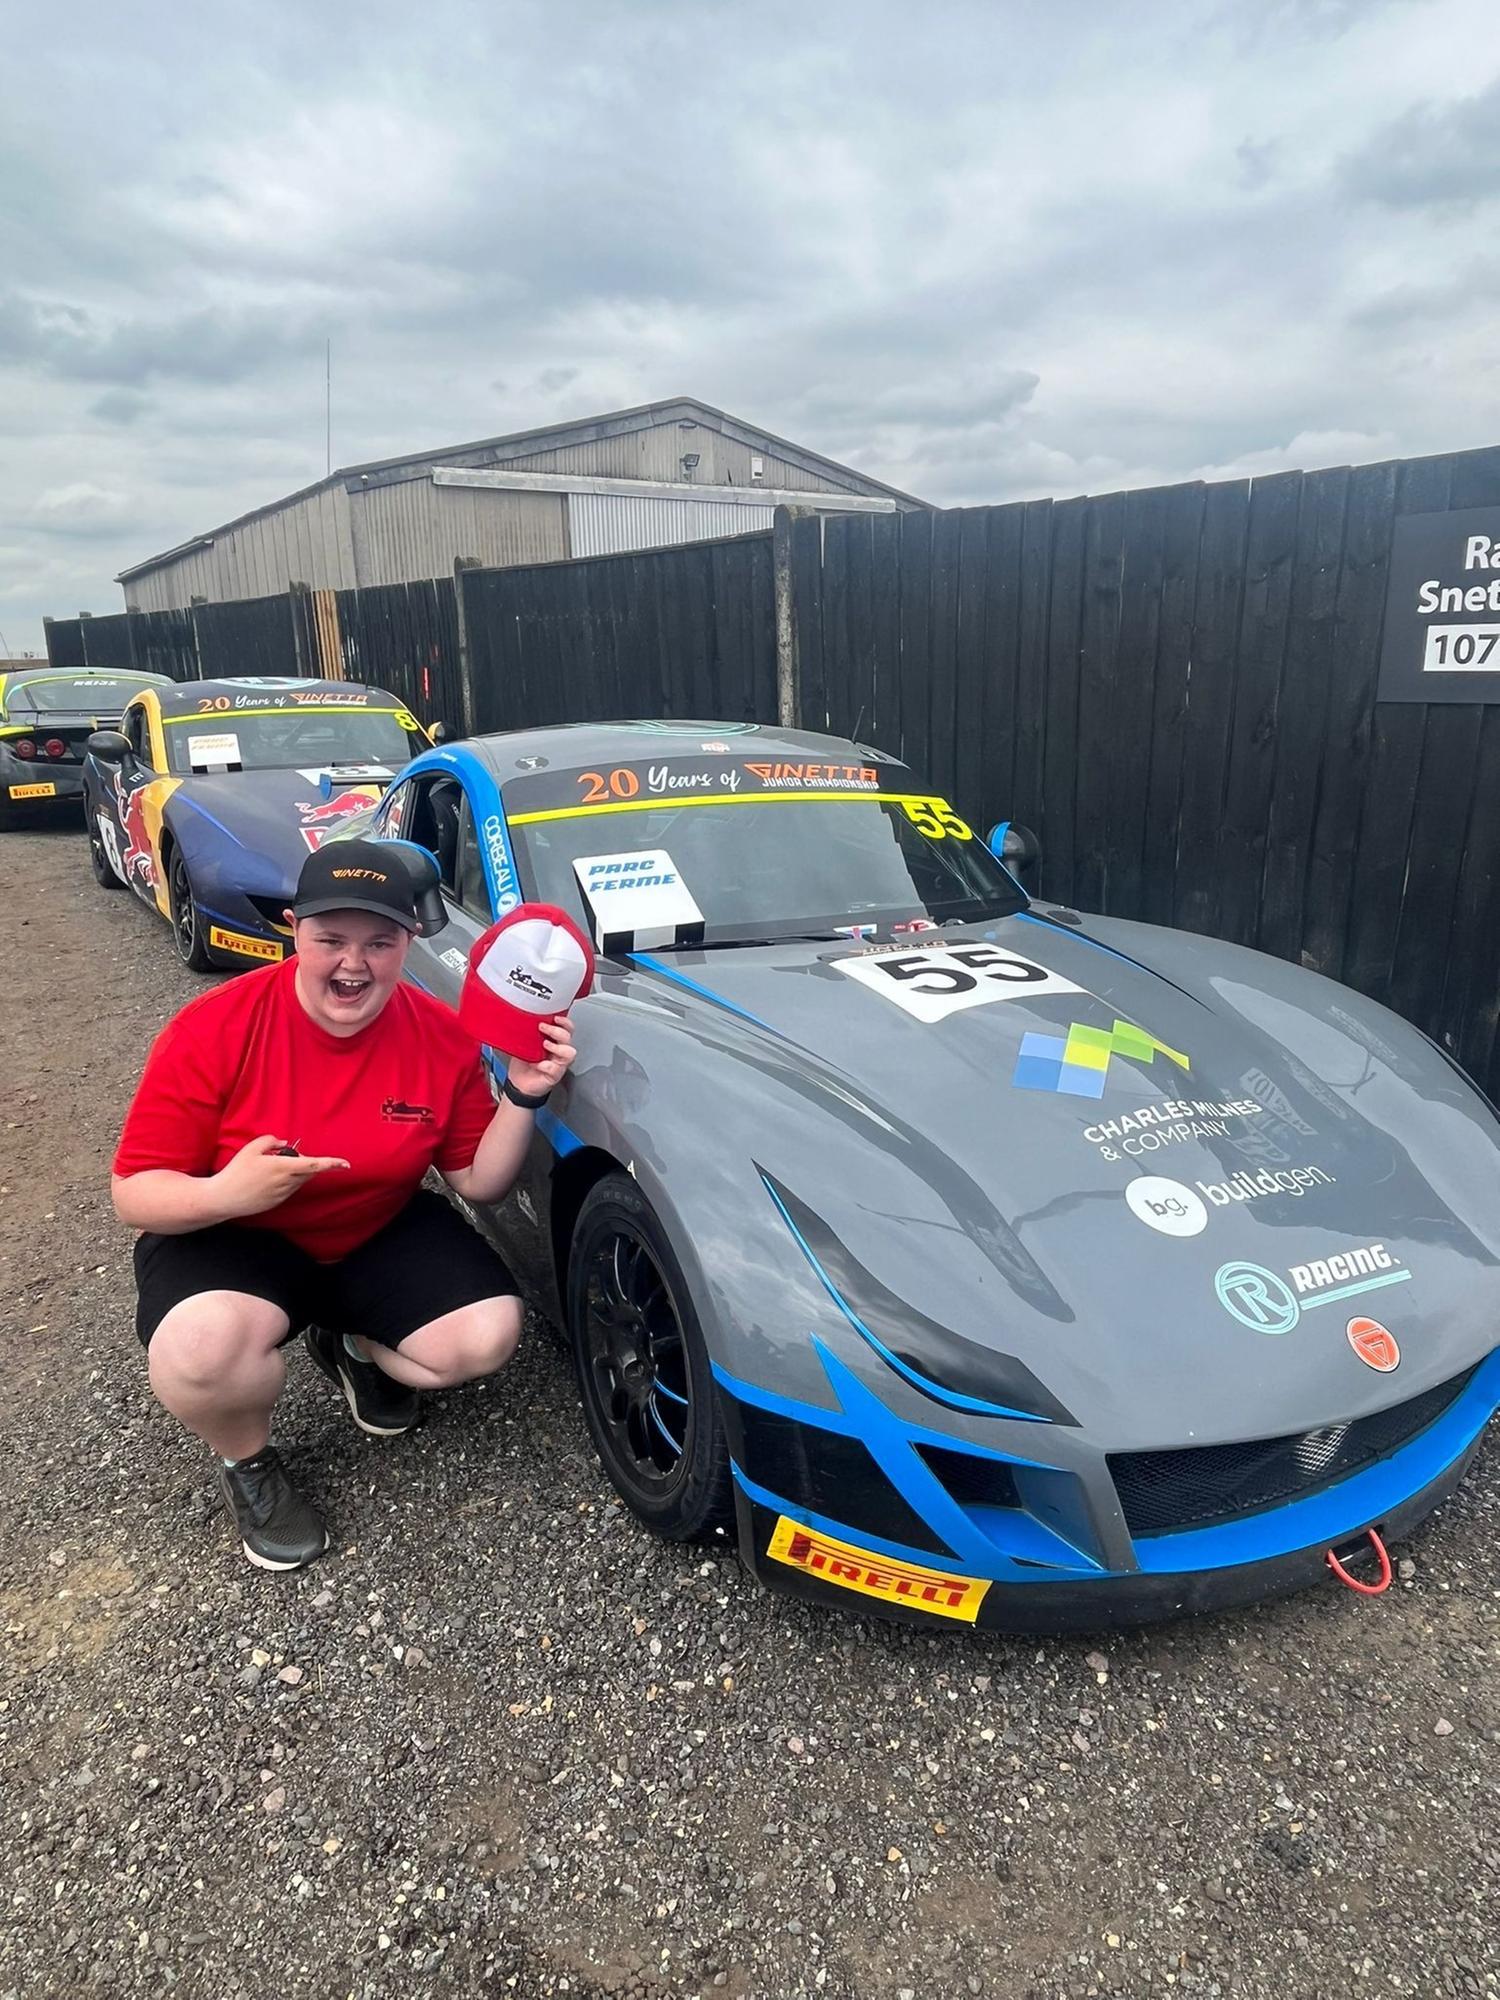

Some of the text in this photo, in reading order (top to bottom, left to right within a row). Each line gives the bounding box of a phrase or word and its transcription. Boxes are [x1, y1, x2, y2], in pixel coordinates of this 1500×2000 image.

[1435, 633, 1500, 664] 107
[199, 697, 231, 713] 20
[235, 695, 269, 709] Years
[275, 697, 287, 707] of
[394, 712, 418, 731] 8
[577, 763, 878, 803] 20 Years of GINETTA
[762, 777, 880, 790] JUNIOR CHAMPIONSHIP
[901, 801, 973, 841] 55
[485, 815, 514, 893] CORBEAU
[588, 860, 656, 876] PARC
[332, 868, 388, 882] GINETTA
[589, 874, 677, 892] FERME
[874, 949, 1050, 996] 55
[1083, 1100, 1194, 1143] CHARLES
[1191, 1100, 1263, 1118] MILNES
[1100, 1120, 1231, 1162] & COMPANY
[1195, 1164, 1337, 1207] buildgen.
[1144, 1196, 1189, 1217] bg.
[788, 1531, 970, 1607] PIRELLI
